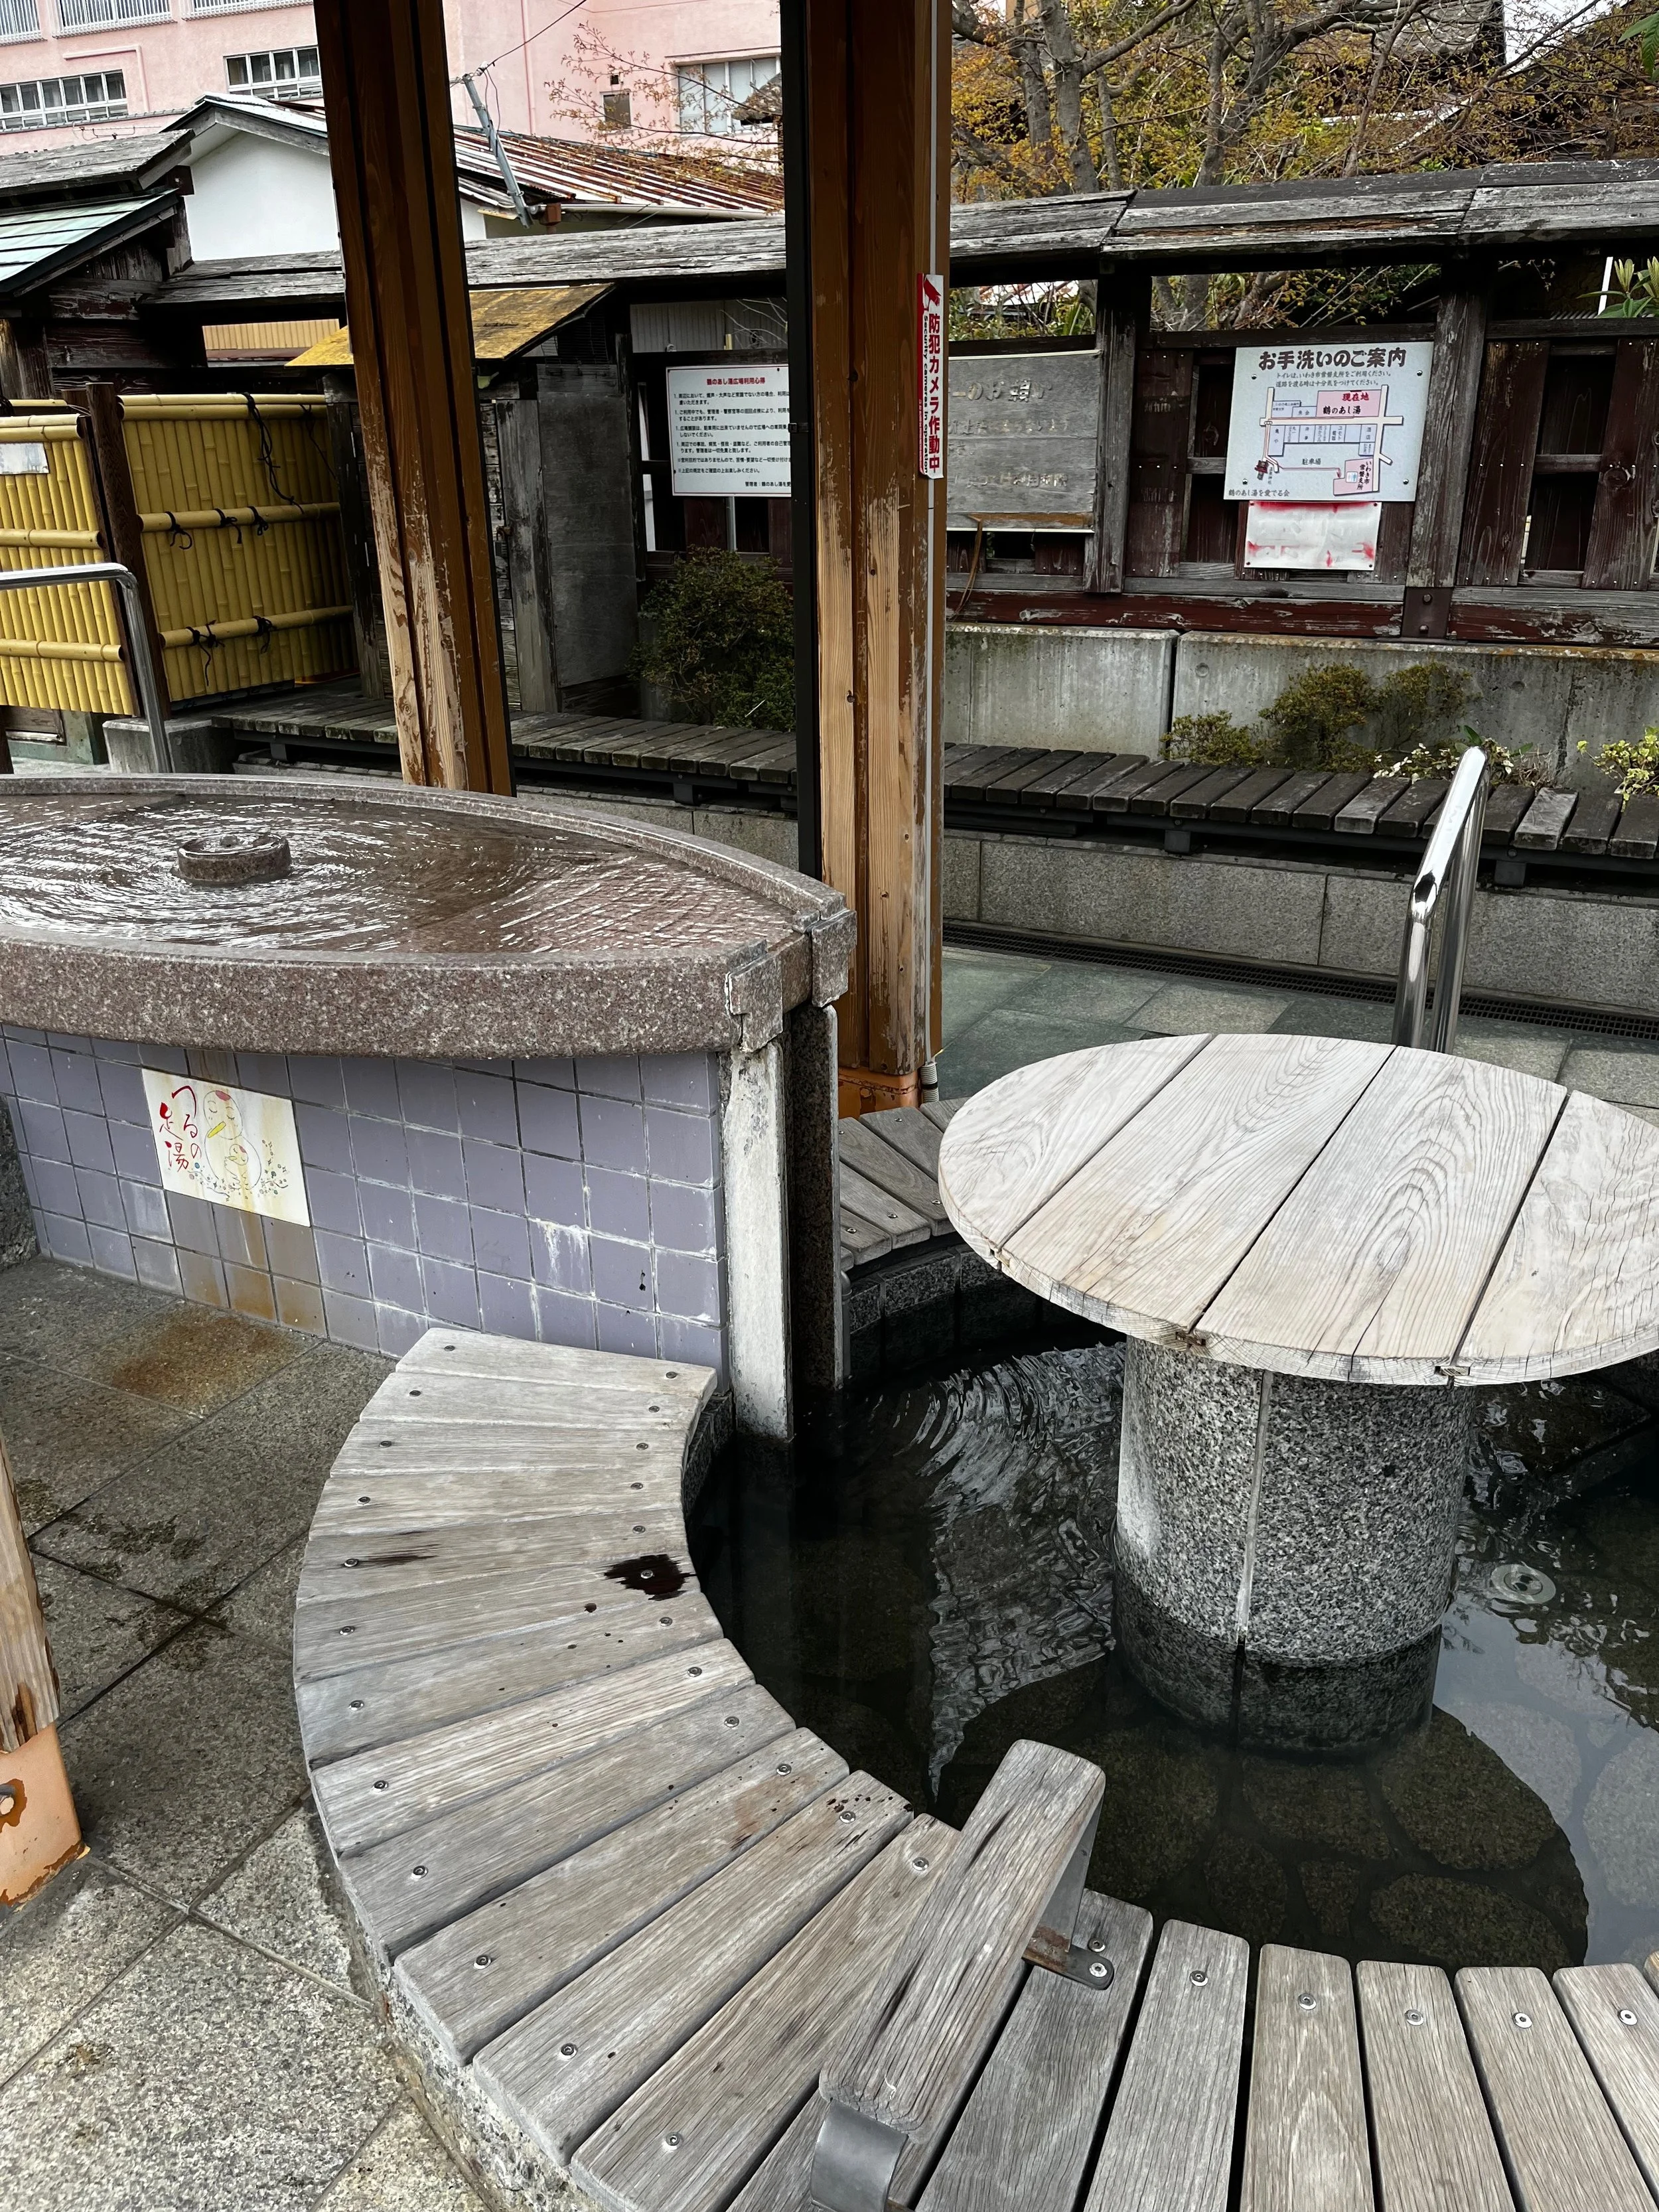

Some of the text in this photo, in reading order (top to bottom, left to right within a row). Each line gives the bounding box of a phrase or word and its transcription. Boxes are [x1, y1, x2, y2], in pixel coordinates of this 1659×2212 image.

[1258, 347, 1407, 370] お手洗いのご案内
[928, 313, 940, 473] 防犯カメラ作動中
[948, 378, 1052, 403] ーのお願い
[1342, 392, 1370, 402] 現在地
[924, 411, 928, 421] in
[1323, 406, 1360, 415] 鶴のあし湯
[1364, 461, 1372, 484] いわき市
[171, 1085, 202, 1159] つるの
[159, 1102, 189, 1173] 足湯
